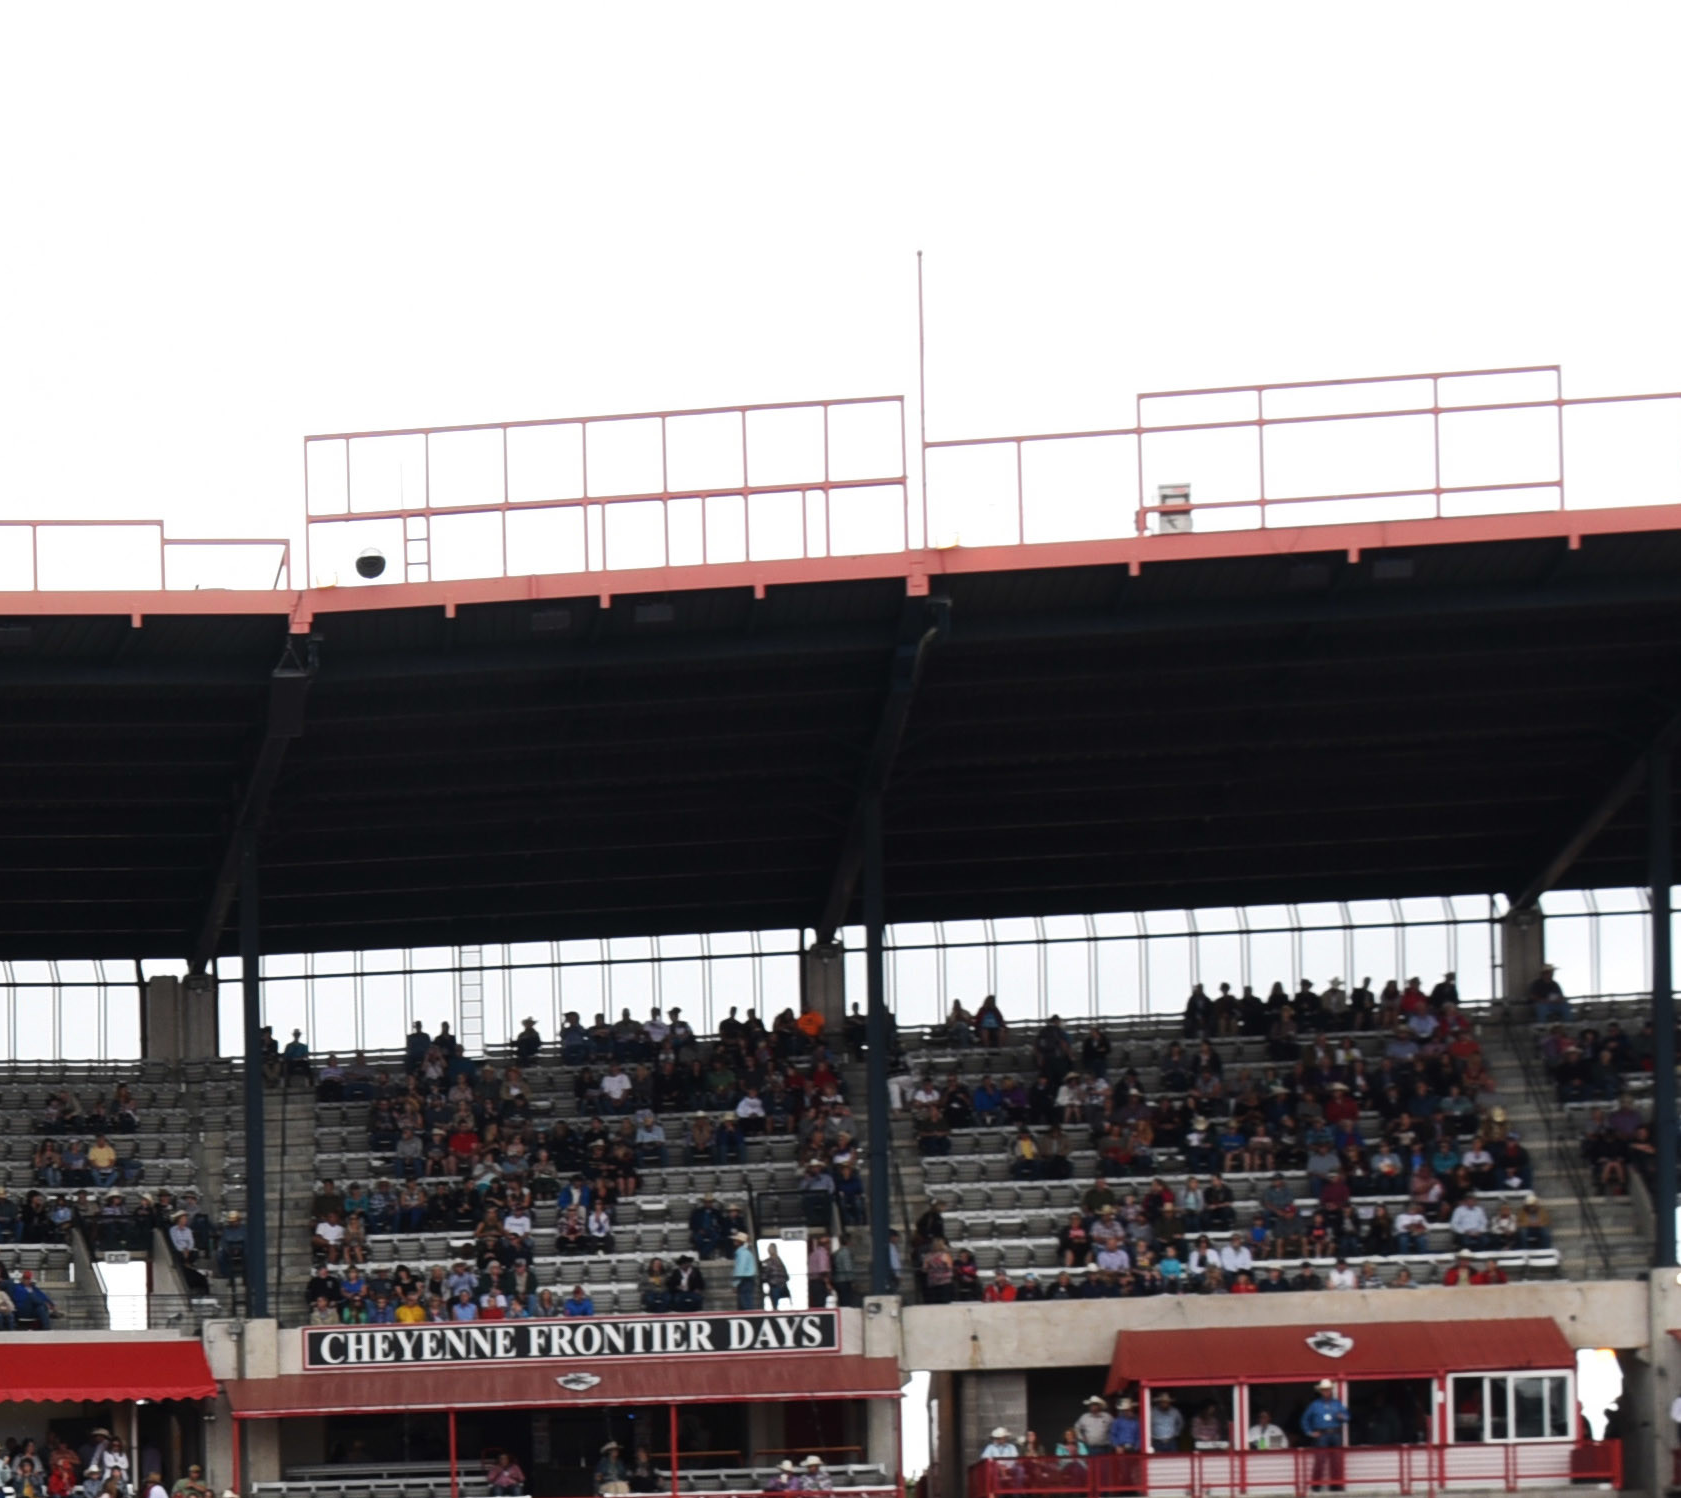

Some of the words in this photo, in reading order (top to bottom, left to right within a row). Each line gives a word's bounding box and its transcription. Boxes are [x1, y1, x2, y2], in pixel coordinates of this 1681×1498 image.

[319, 1328, 518, 1364] CHEYENNE
[527, 1320, 713, 1357] FRONTIER
[729, 1315, 823, 1350] DAYS
